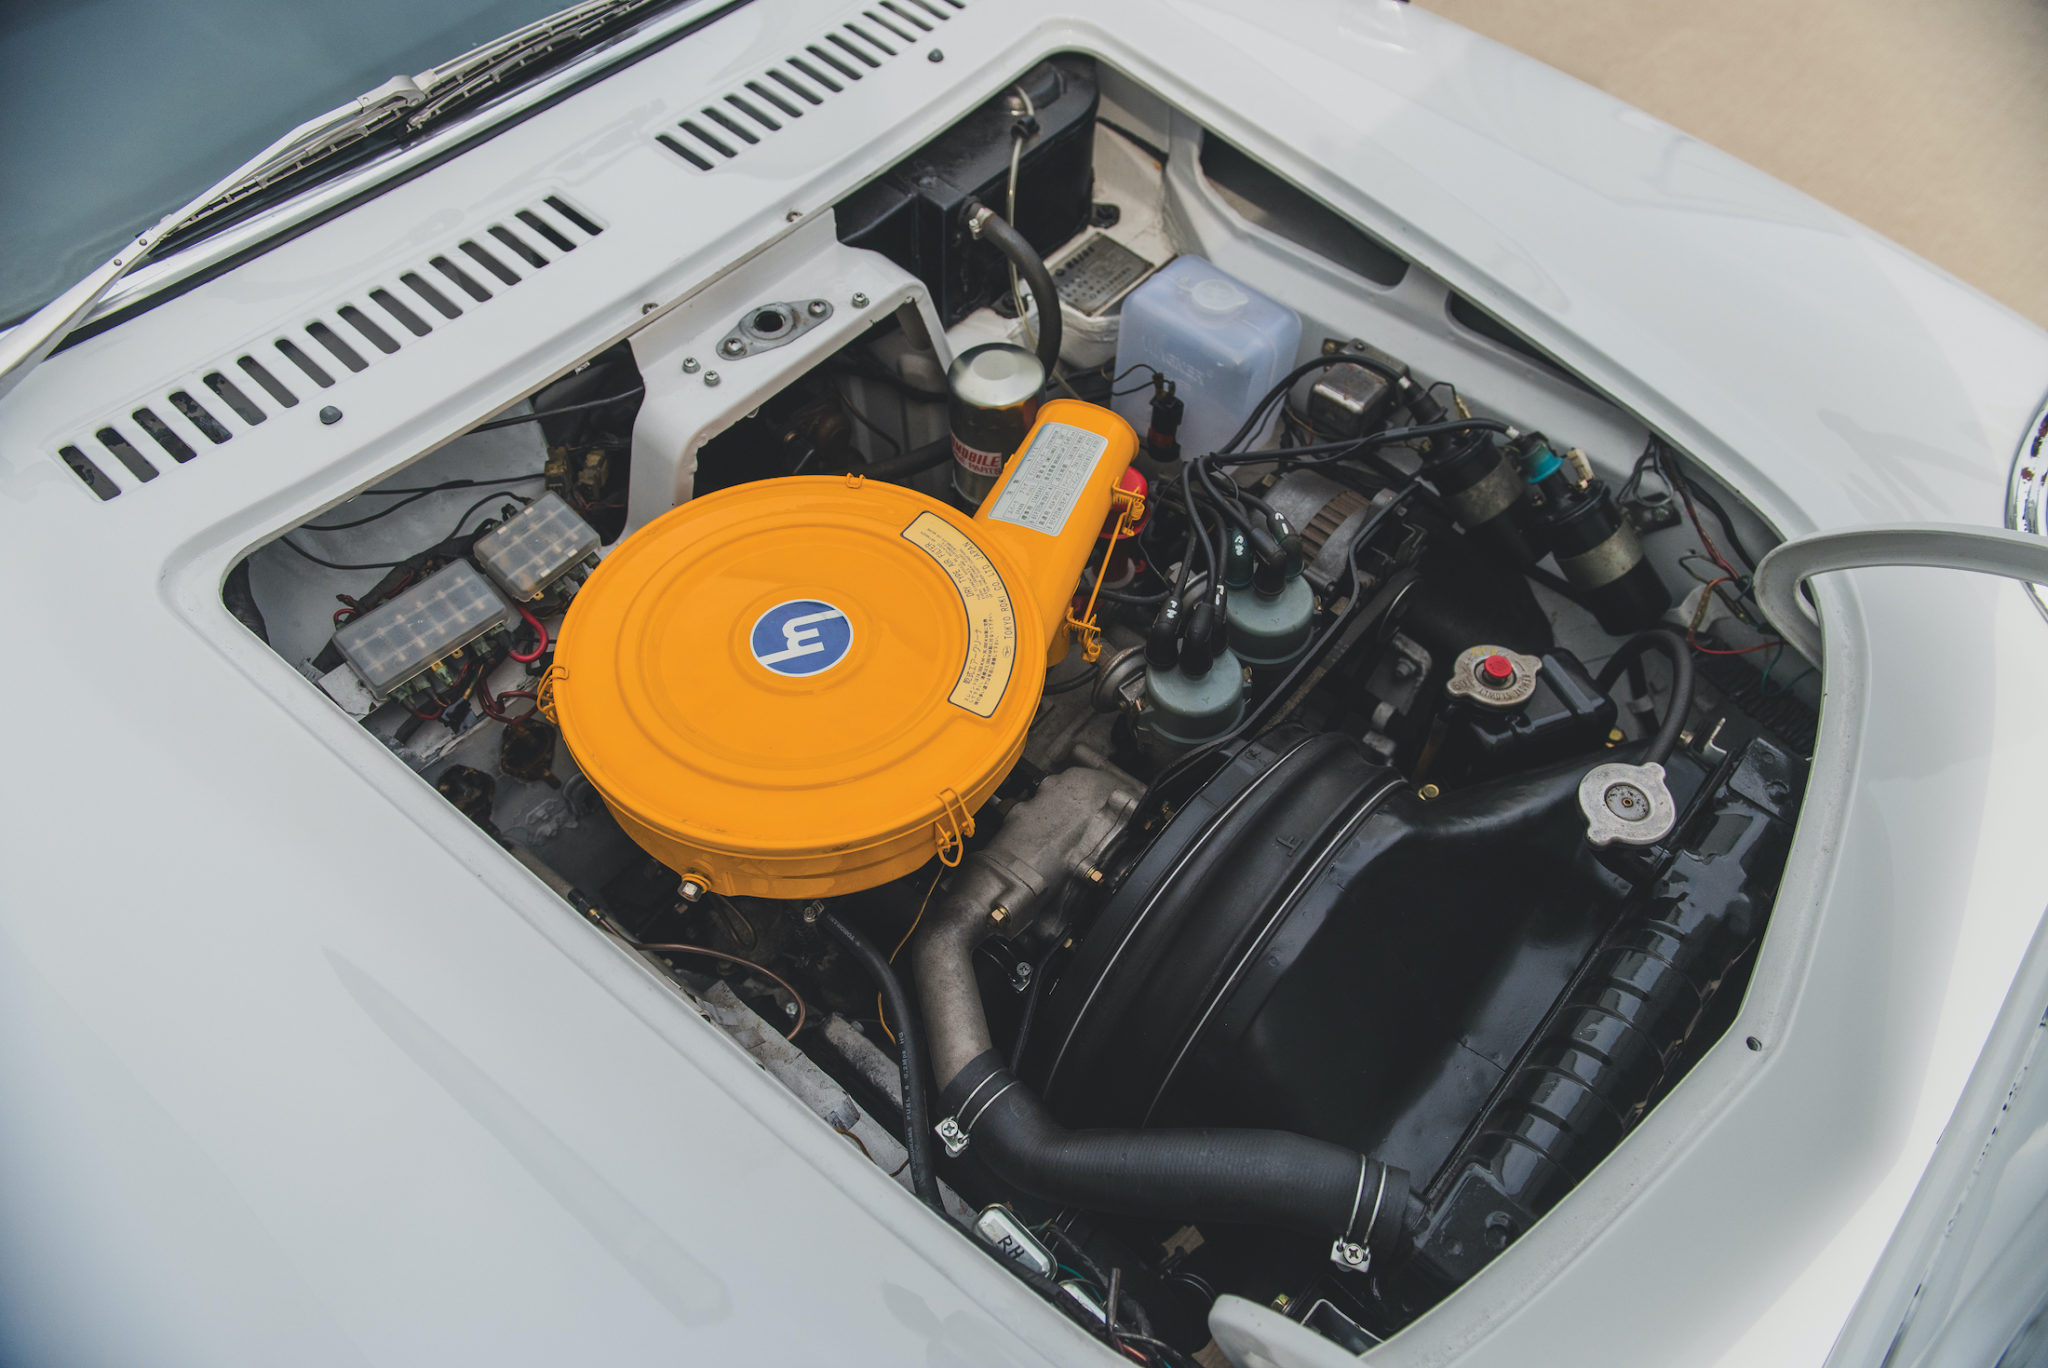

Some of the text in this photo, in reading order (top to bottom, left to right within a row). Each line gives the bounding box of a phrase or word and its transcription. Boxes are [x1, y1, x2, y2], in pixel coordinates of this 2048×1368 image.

[925, 541, 945, 558] FILTER
[964, 541, 984, 561] JAPAN
[943, 559, 955, 568] AIR
[953, 569, 966, 584] TYPE
[1003, 616, 1013, 640] TOKYO
[998, 1235, 1025, 1260] RH
